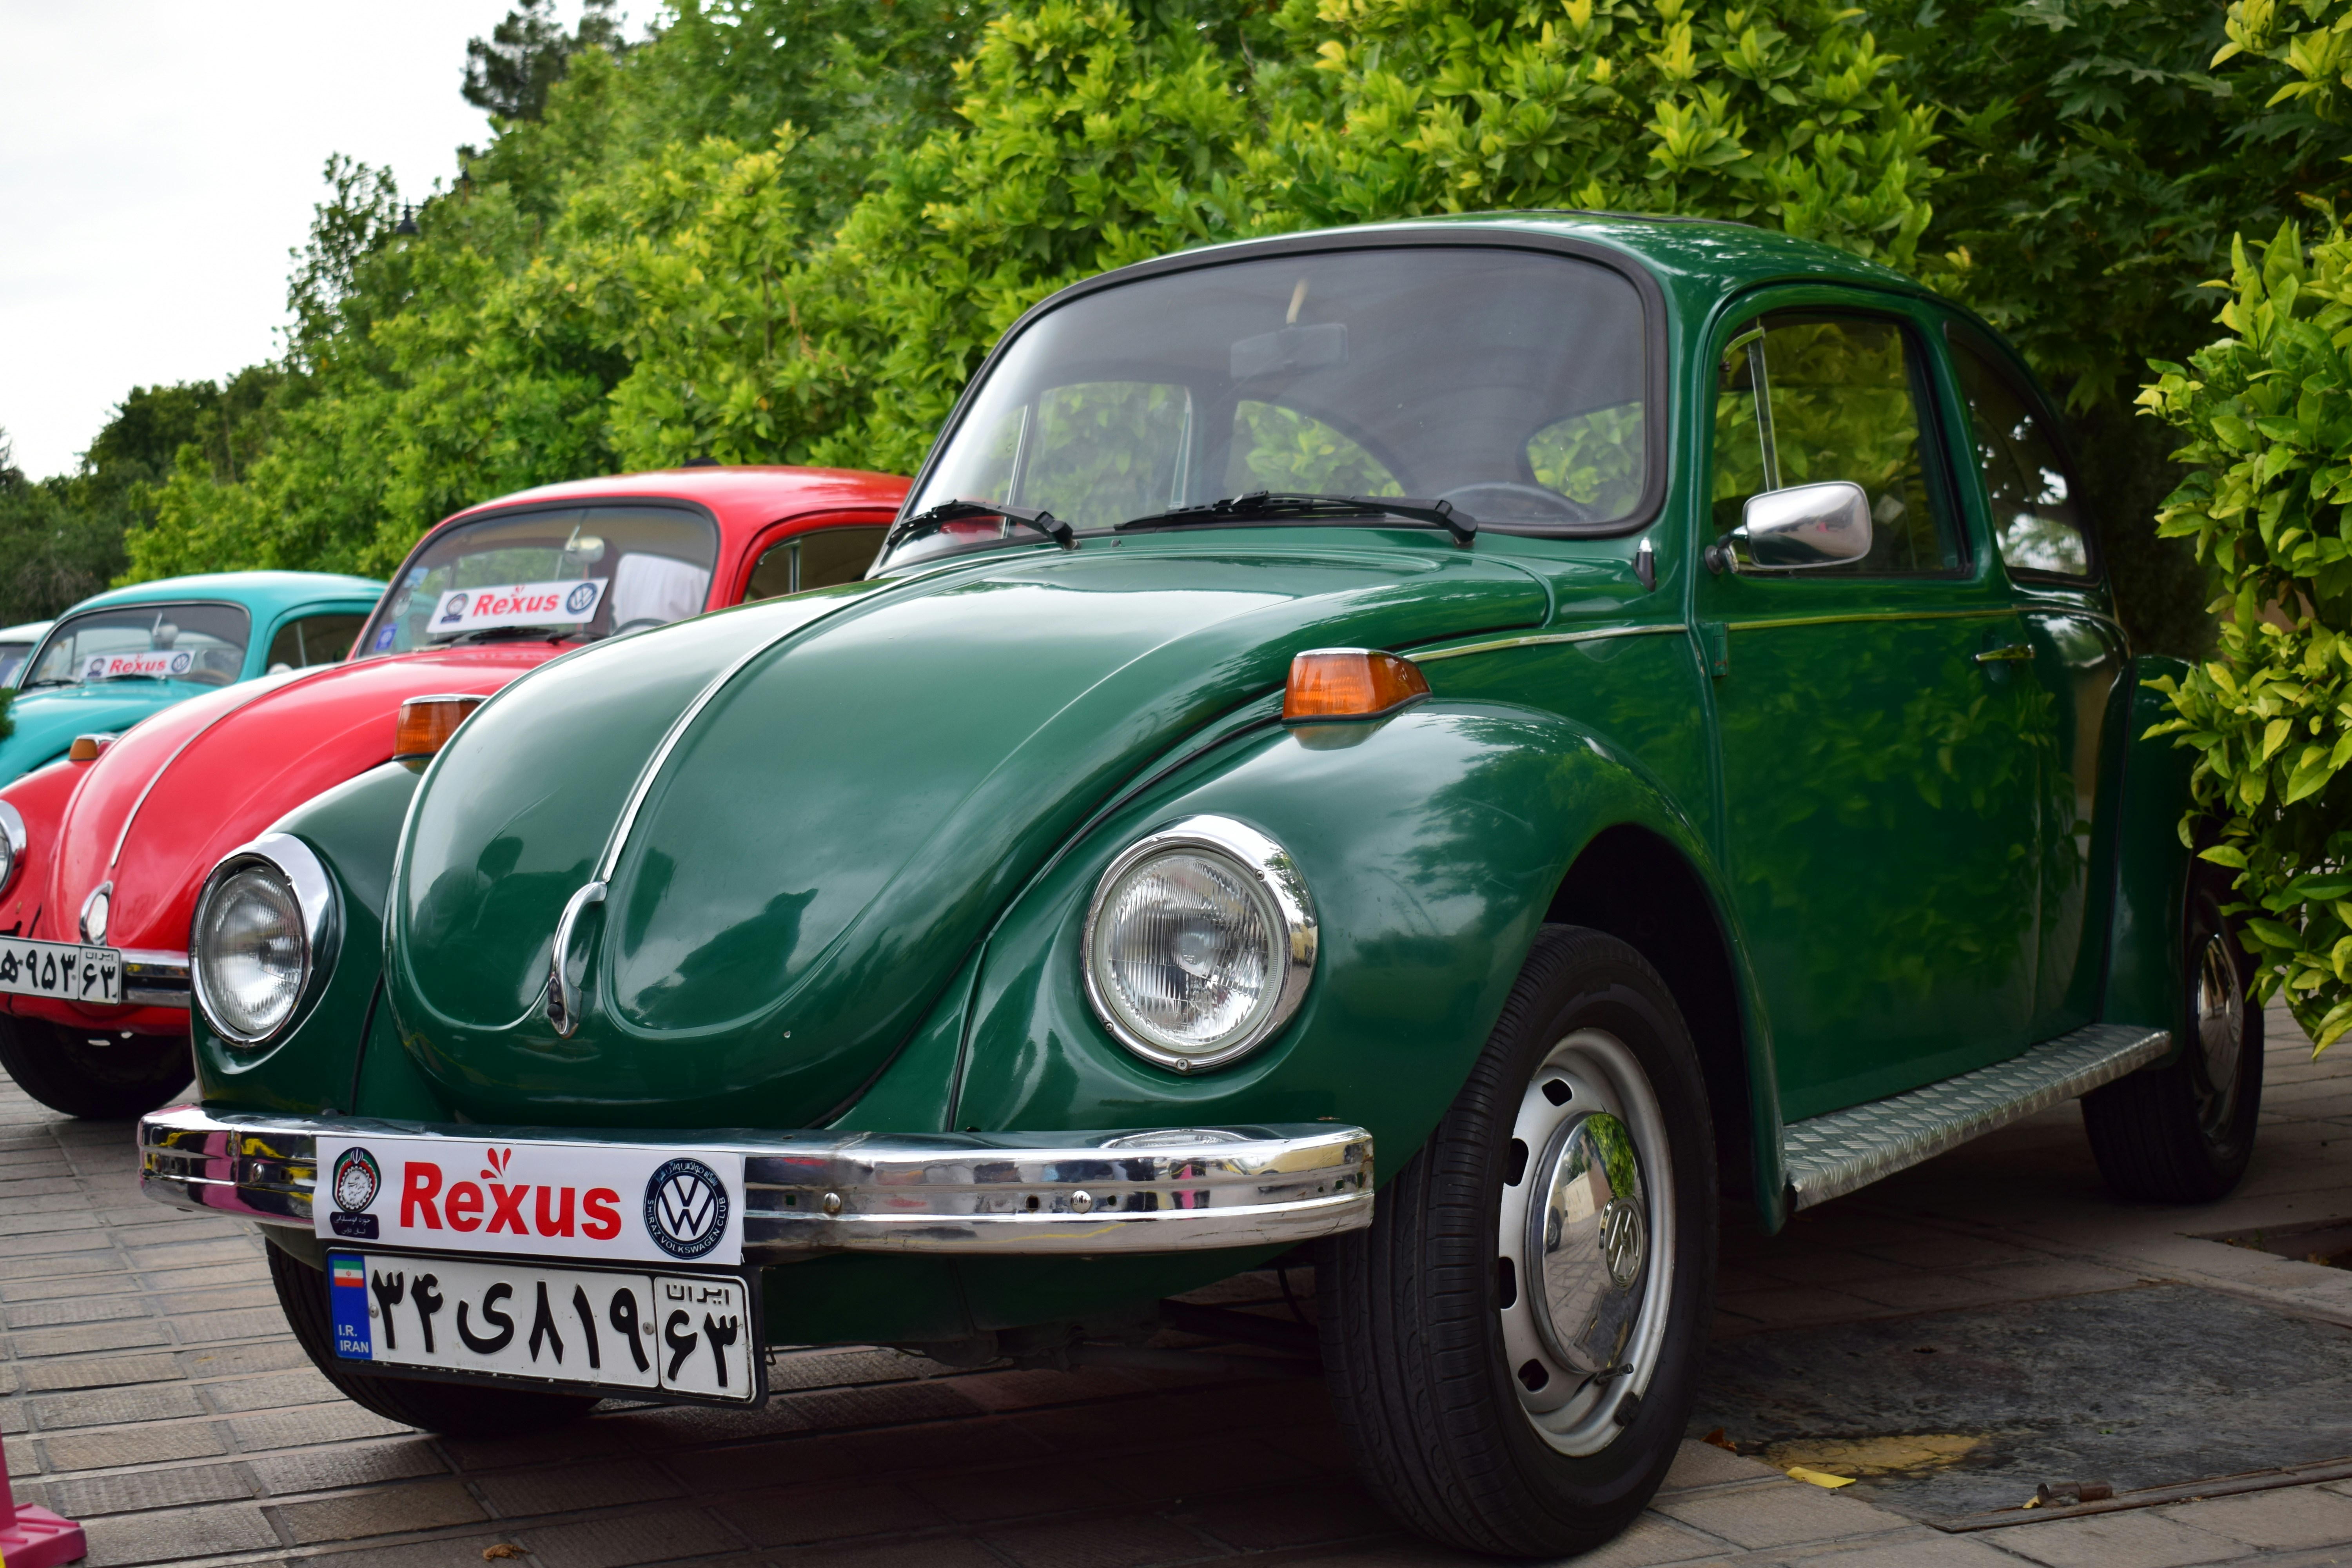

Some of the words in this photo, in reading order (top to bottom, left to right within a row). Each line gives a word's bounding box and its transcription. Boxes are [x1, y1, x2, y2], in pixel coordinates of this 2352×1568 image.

[472, 593, 560, 617] Rexus
[109, 659, 167, 674] Rexus
[85, 951, 114, 961] ایران
[82, 963, 115, 998] ۶۳
[400, 1161, 622, 1240] Rexus
[647, 1200, 661, 1238] SHIRAZ
[660, 1228, 720, 1254] VOLKSWAGEN
[717, 1196, 726, 1227] CLUB
[666, 1284, 730, 1306] ایران
[338, 1324, 358, 1337] I.R.
[340, 1340, 369, 1353] IRAN
[664, 1308, 738, 1387] ۶۳
